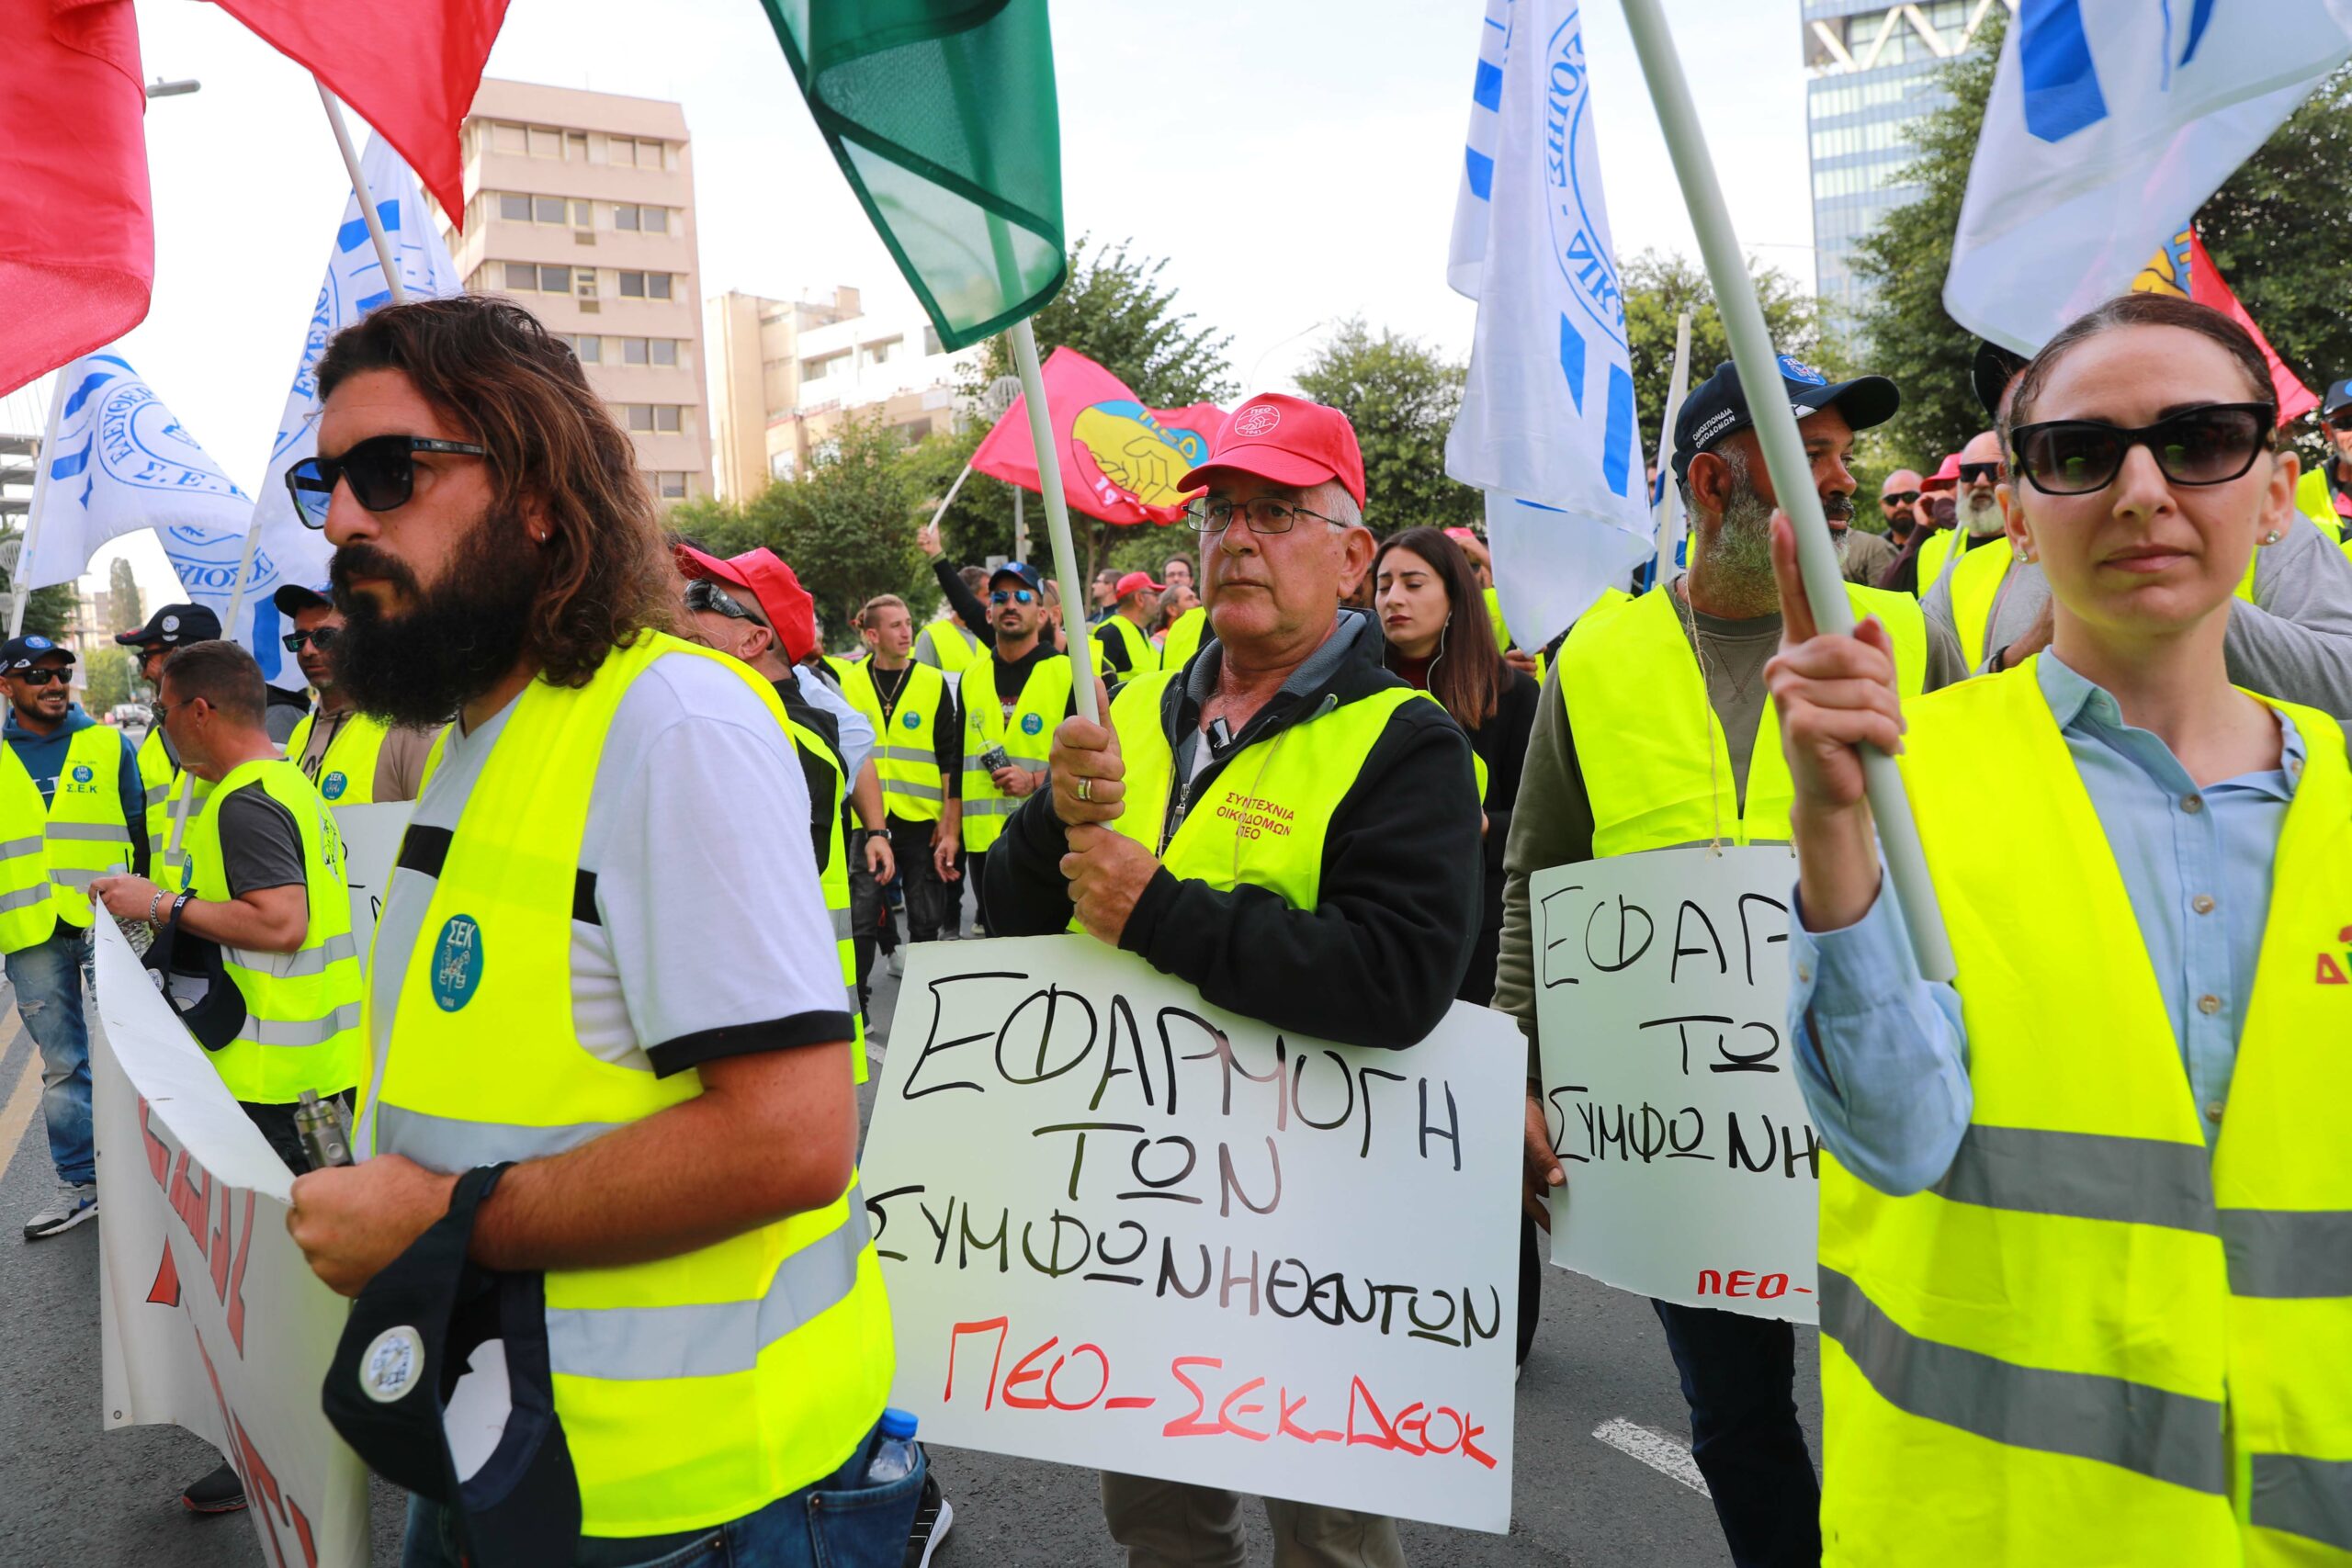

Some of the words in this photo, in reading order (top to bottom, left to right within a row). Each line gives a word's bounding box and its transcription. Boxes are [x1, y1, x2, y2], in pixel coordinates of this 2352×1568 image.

[1692, 407, 1734, 441] ΟΜΟΣΠΟΝΔΙΑ
[1696, 414, 1736, 449] ΟΙΚΟΔΟΜΩΝ
[65, 783, 98, 795] Σ.Ε.Κ
[1226, 792, 1295, 821] ΣΥΝΤΕΧΝΙΑ
[1216, 806, 1292, 837] ΟΙΚΟΔΟΜΩΝ
[1236, 826, 1261, 840] ΠΕΟ
[447, 919, 478, 949] ΣΕΚ
[1541, 886, 1790, 988] ΕΦΑΡ
[1639, 1014, 1780, 1075] ΤΩ
[903, 972, 1462, 1171] ΕΦΑΡΜΟΓΗ
[1548, 1086, 1820, 1180] ΣΥΜΦΩΝΗ
[1033, 1122, 1282, 1217] ΤΩΝ
[865, 1184, 1500, 1348] ΣΥΜΦΩΝΗΘΕΝΤΩΝ
